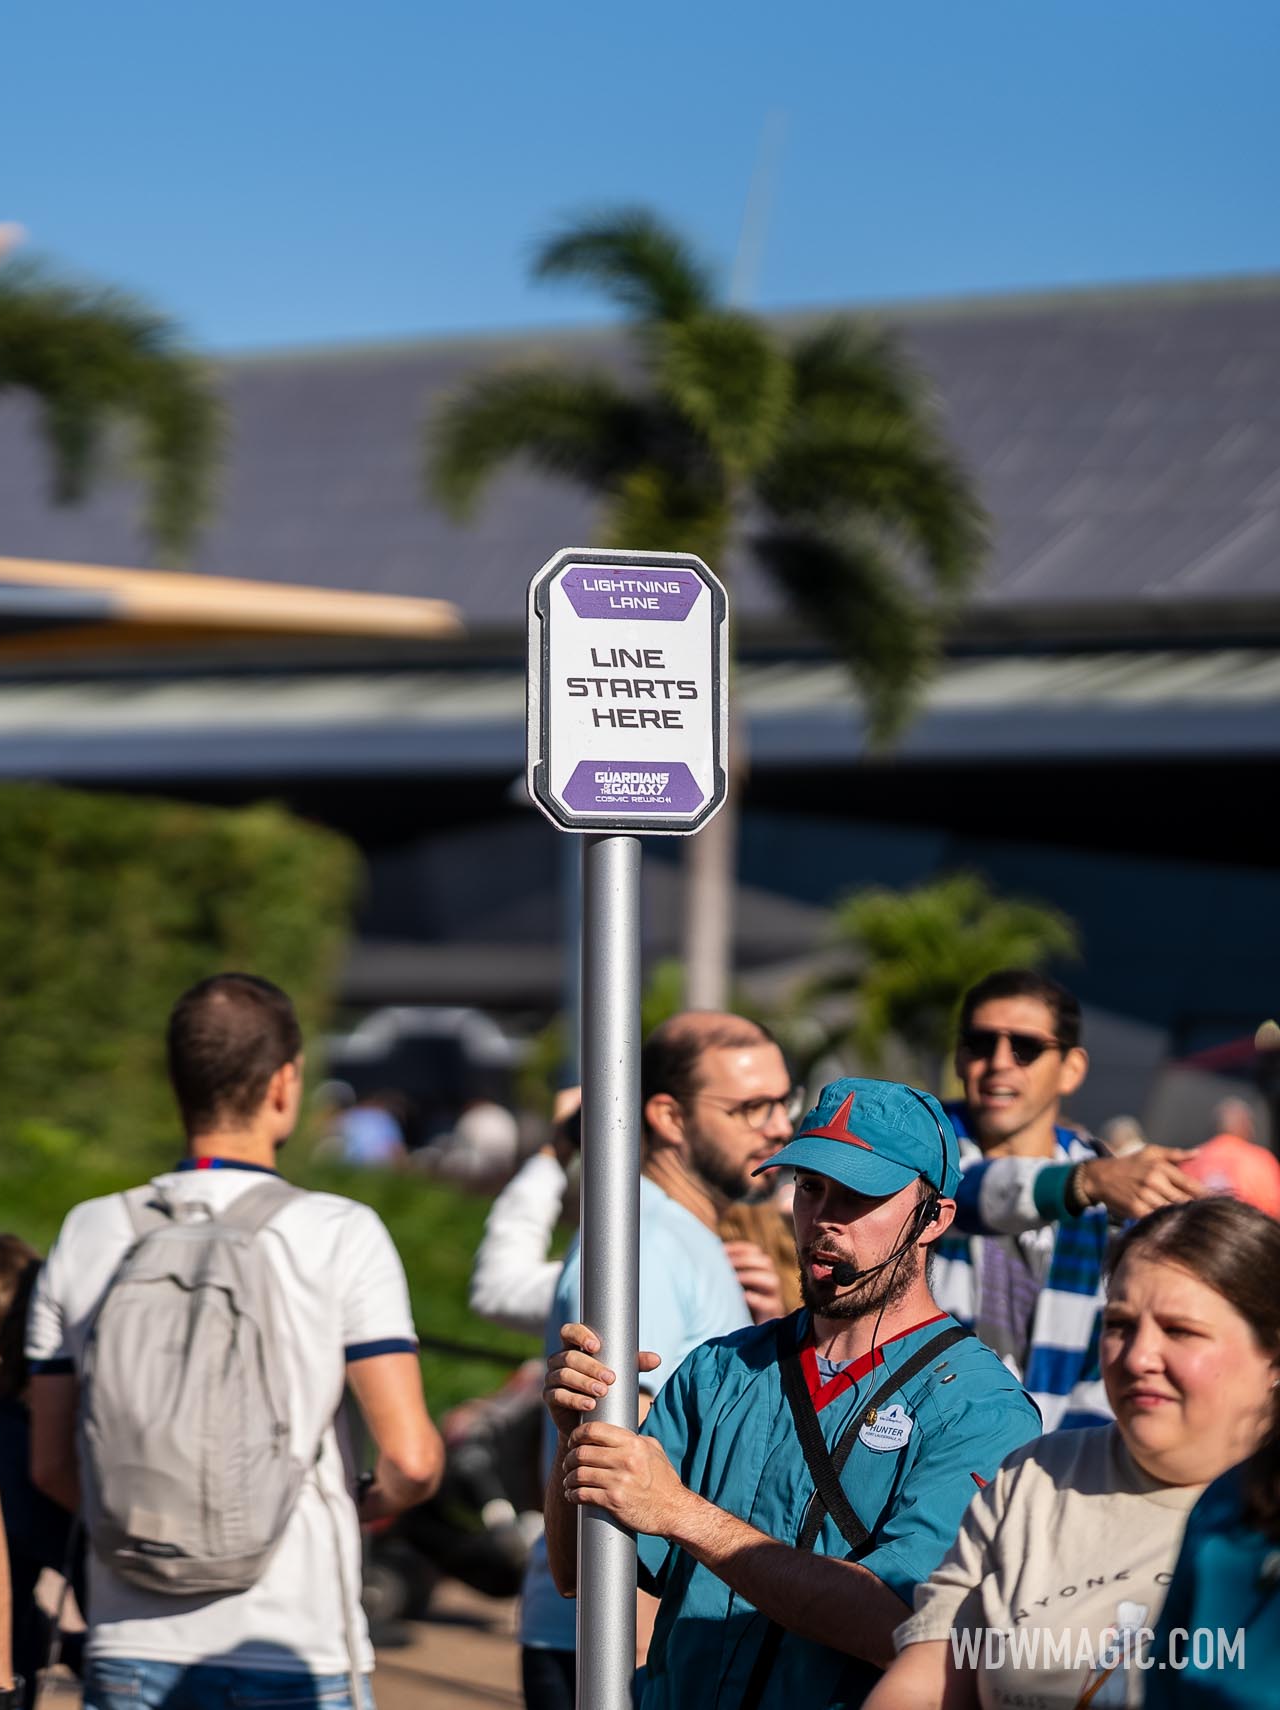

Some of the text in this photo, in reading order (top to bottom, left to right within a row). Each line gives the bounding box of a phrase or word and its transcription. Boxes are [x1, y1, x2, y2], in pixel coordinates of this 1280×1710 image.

[582, 579, 681, 594] LIGHTNING
[609, 596, 660, 610] LANE
[590, 647, 666, 669] LINE
[566, 677, 698, 700] STARTS
[591, 708, 684, 729] HERE
[595, 772, 670, 784] GUARDIANS
[612, 784, 667, 795] GALAXY
[870, 1424, 904, 1437] HUNTER
